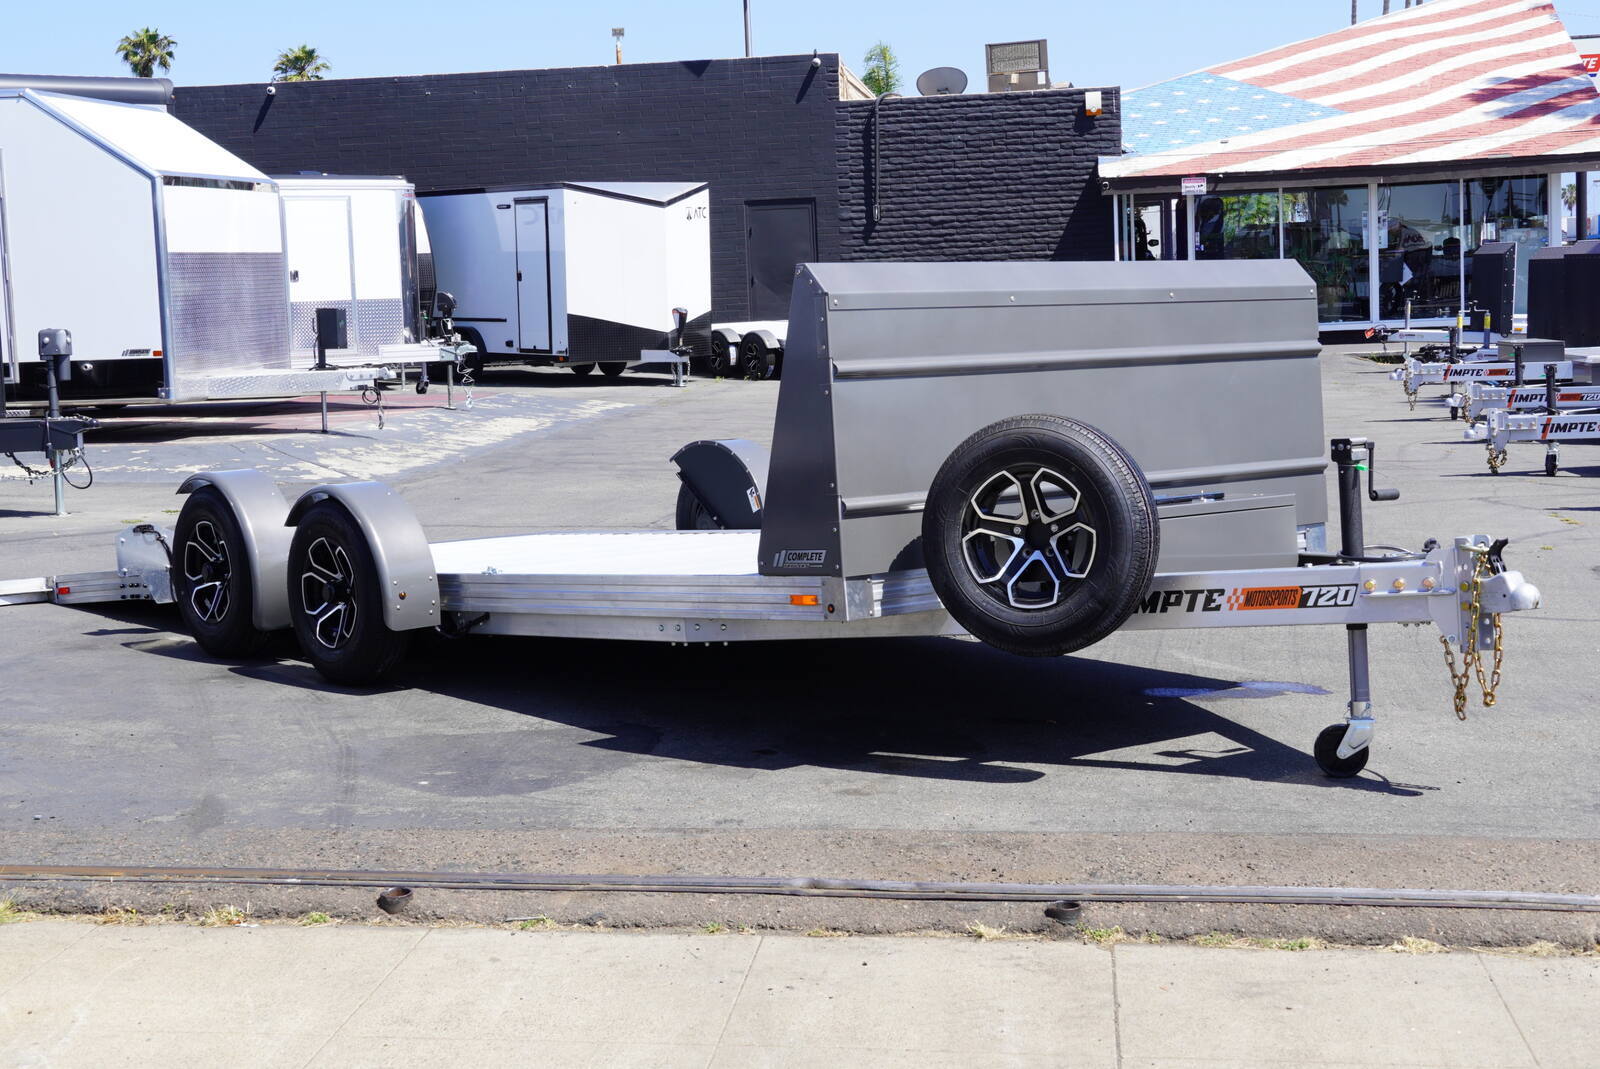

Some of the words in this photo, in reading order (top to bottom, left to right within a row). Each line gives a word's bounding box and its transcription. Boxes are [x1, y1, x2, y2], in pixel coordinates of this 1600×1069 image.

[693, 207, 707, 219] ATC
[1442, 366, 1484, 379] TIMPTE
[1506, 391, 1548, 406] TIMPT
[1540, 418, 1598, 438] TIMPTE
[787, 551, 823, 561] COMPLETE
[1244, 589, 1299, 607] MOTORSPORTS
[1302, 586, 1357, 606] 720
